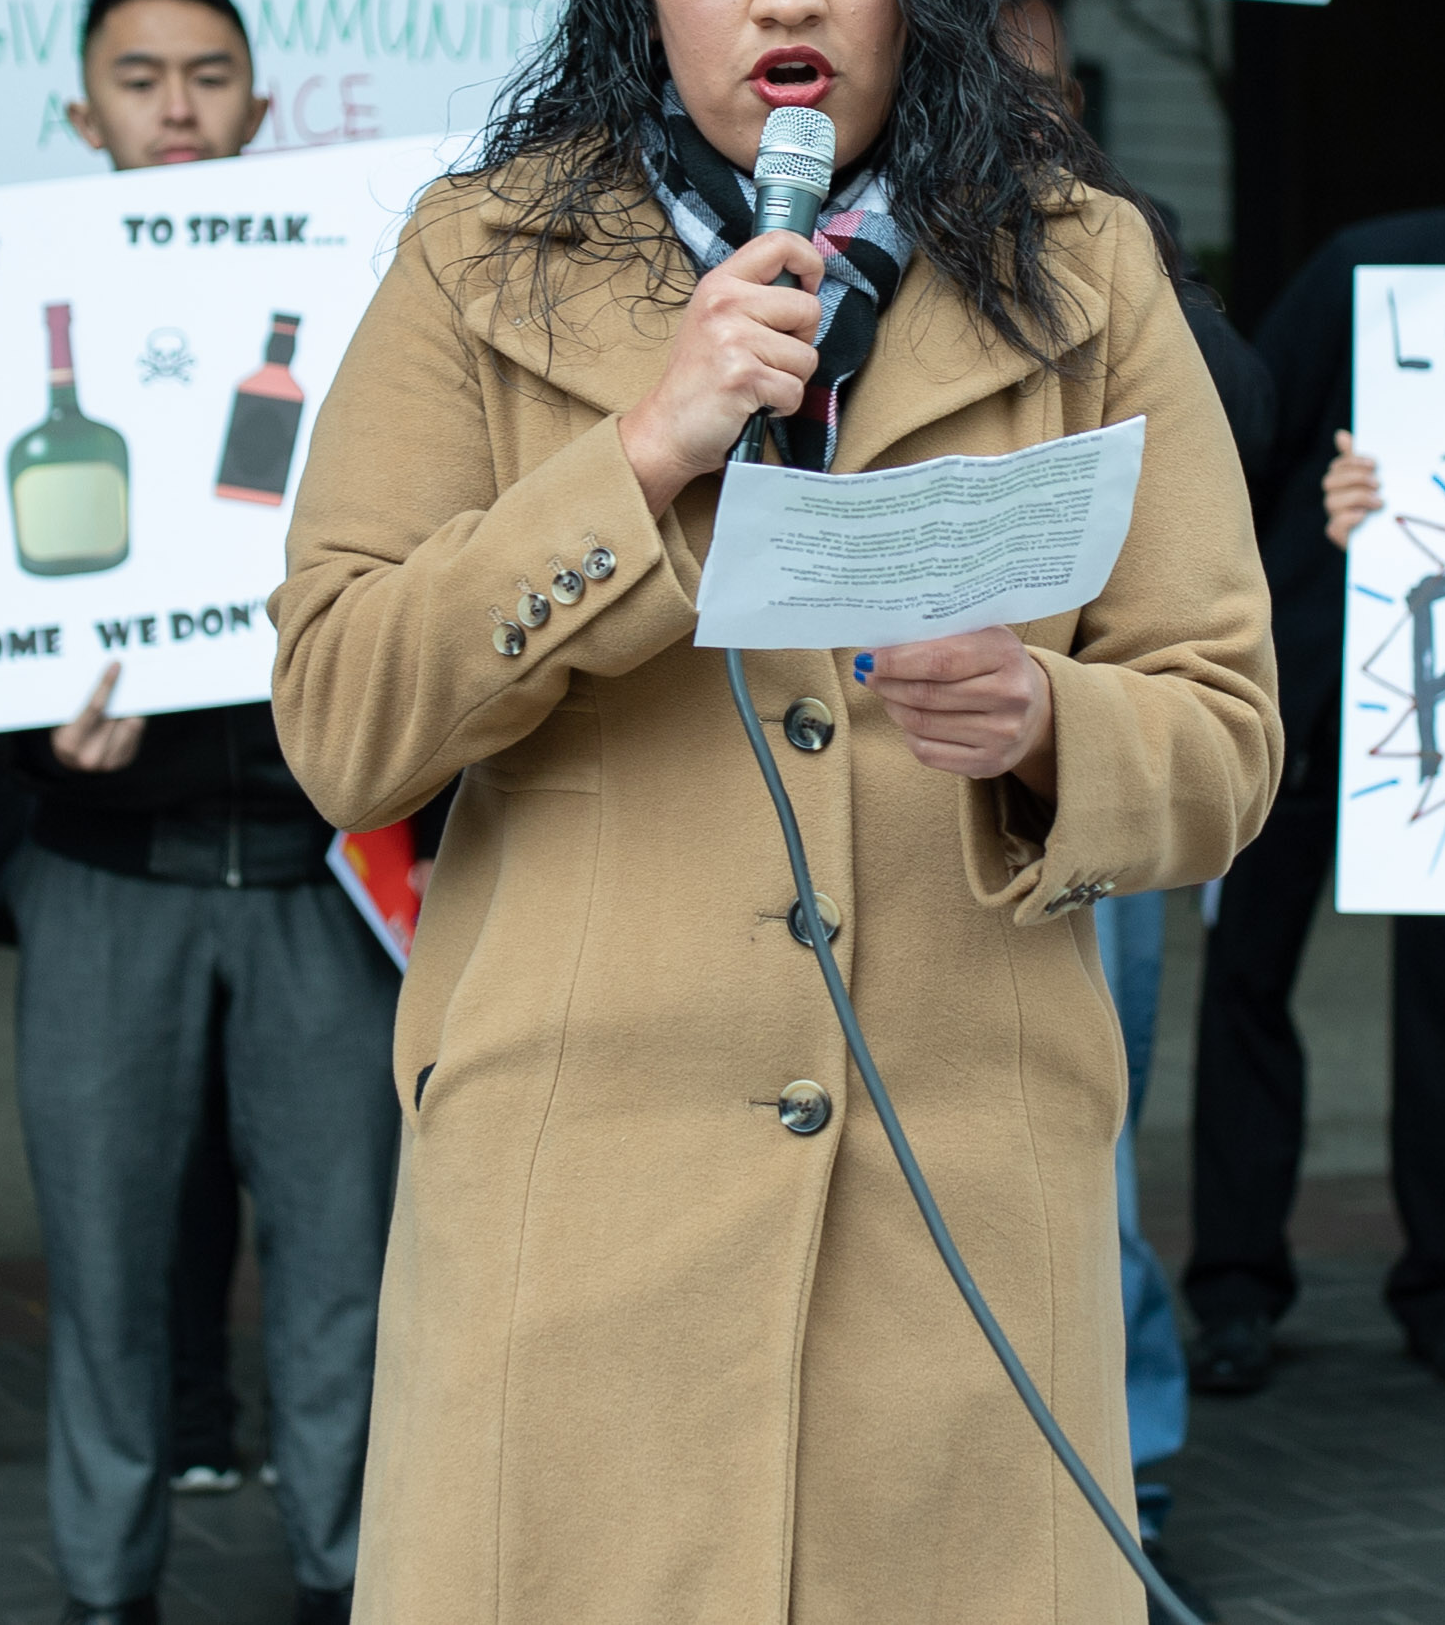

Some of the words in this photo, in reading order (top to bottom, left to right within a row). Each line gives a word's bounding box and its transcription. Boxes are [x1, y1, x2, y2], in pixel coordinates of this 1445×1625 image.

[263, 71, 381, 146] ICE
[123, 214, 173, 246] TO
[93, 615, 157, 650] WE
[168, 599, 267, 642] DON'
